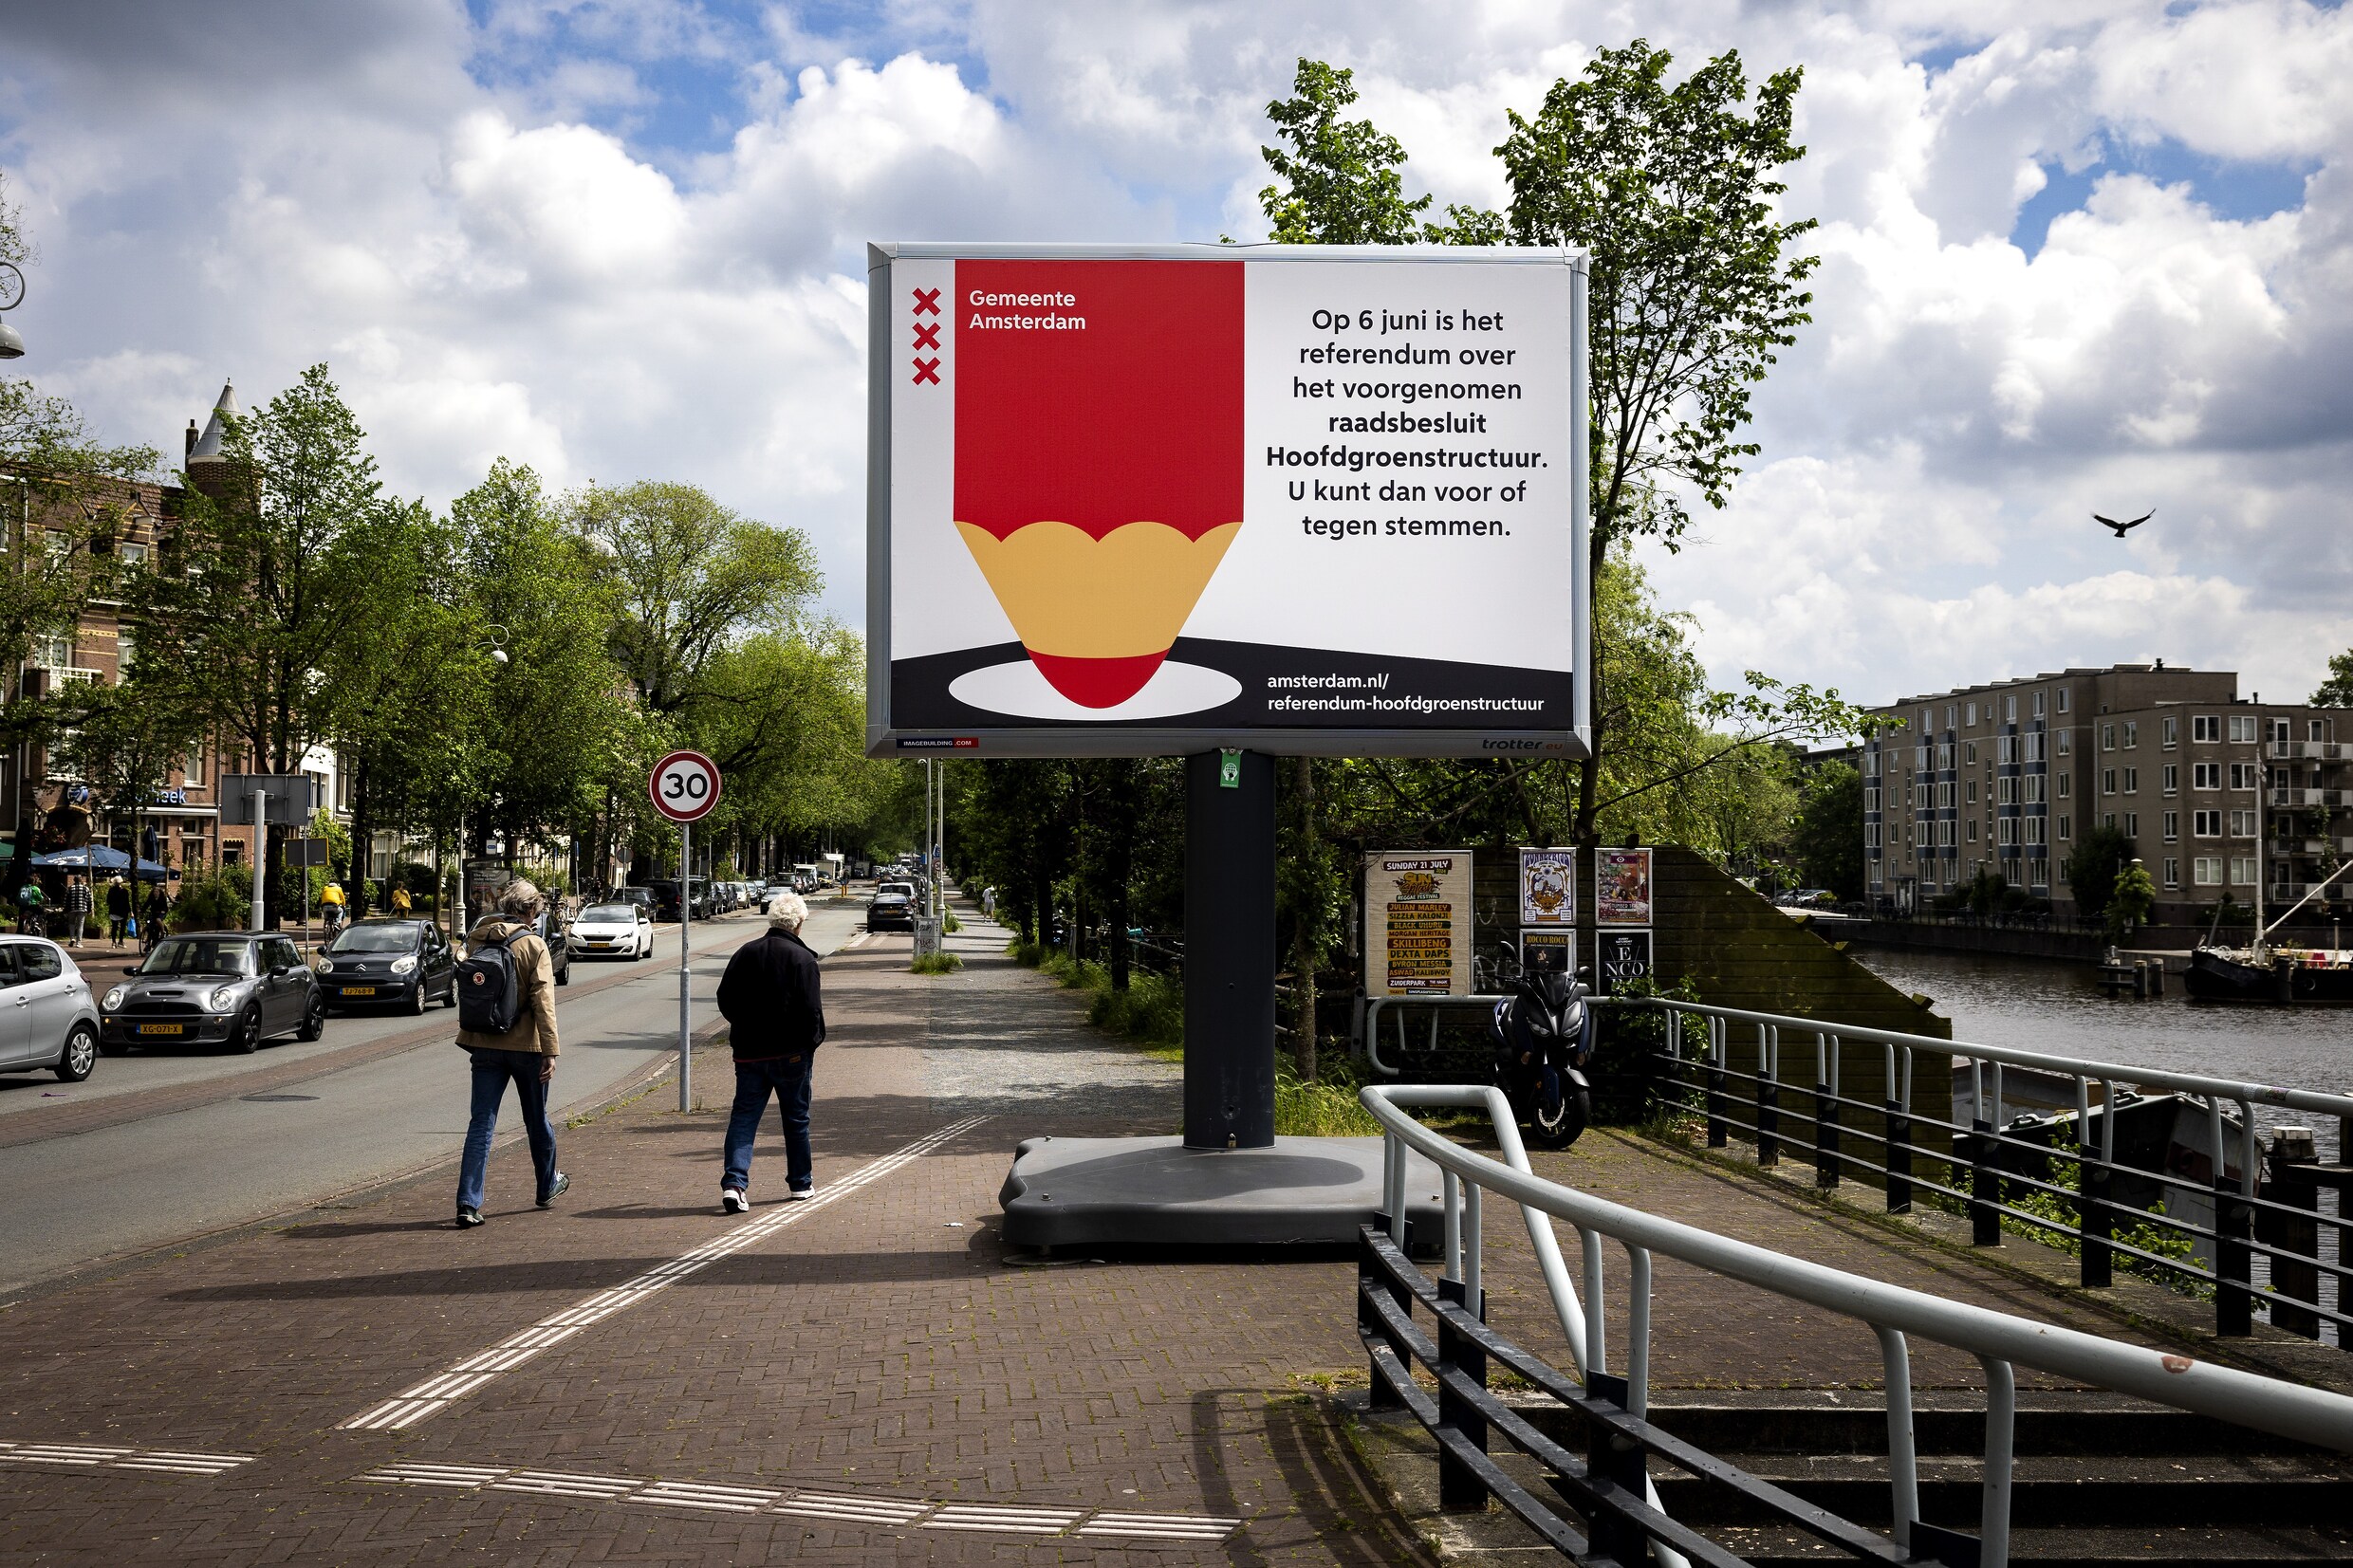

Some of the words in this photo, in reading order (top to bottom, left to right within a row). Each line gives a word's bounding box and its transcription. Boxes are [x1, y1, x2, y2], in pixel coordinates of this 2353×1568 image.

[969, 289, 1076, 307] Gemeente
[969, 312, 1086, 330] Amsterdam
[1312, 309, 1351, 335] Op
[1359, 309, 1374, 330] 6
[1380, 308, 1427, 336] juni
[1436, 309, 1454, 331] is
[1462, 308, 1504, 332] het
[1300, 341, 1451, 365] referendum
[1458, 349, 1516, 366] over
[1293, 376, 1335, 398] het
[1342, 382, 1522, 404] voorgenomen
[1329, 411, 1487, 434] raadsbesluit
[1267, 444, 1548, 472] Hoofdgroenstructuur.
[1288, 481, 1306, 502] U
[1314, 478, 1371, 502] kunt
[1379, 479, 1426, 502] dan
[1434, 486, 1492, 502] voor
[1500, 479, 1527, 503] of
[1302, 515, 1377, 541] tegen
[1384, 516, 1511, 537] stemmen.
[1267, 673, 1390, 691] amsterdam.nl/
[1268, 694, 1545, 714] referendum-hoofdgroenstructuur
[663, 772, 708, 800] 30
[1430, 860, 1449, 869] JULY
[1404, 872, 1432, 883] SUN
[1390, 950, 1420, 958] DEXTA
[1424, 950, 1450, 958] DAPS
[1393, 939, 1447, 949] SKILLIBENG
[1617, 947, 1632, 961] E
